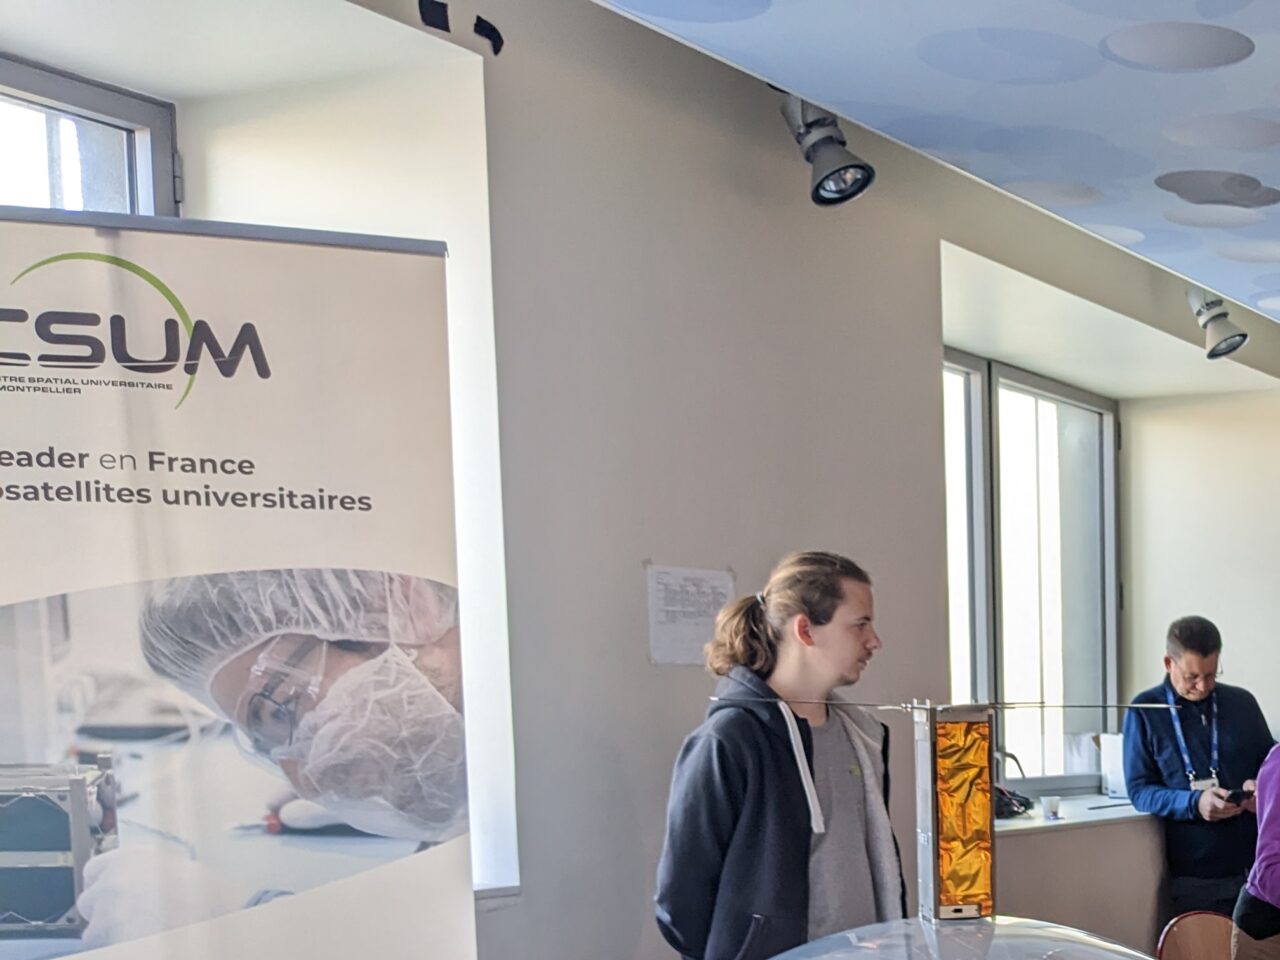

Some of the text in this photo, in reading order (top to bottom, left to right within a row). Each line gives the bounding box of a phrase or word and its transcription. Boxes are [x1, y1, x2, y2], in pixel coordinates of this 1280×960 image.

[28, 377, 79, 385] SPATIAL
[81, 379, 173, 390] UNIVERSITAIRE
[99, 452, 137, 470] en
[148, 452, 255, 476] France
[162, 485, 372, 512] universitaires
